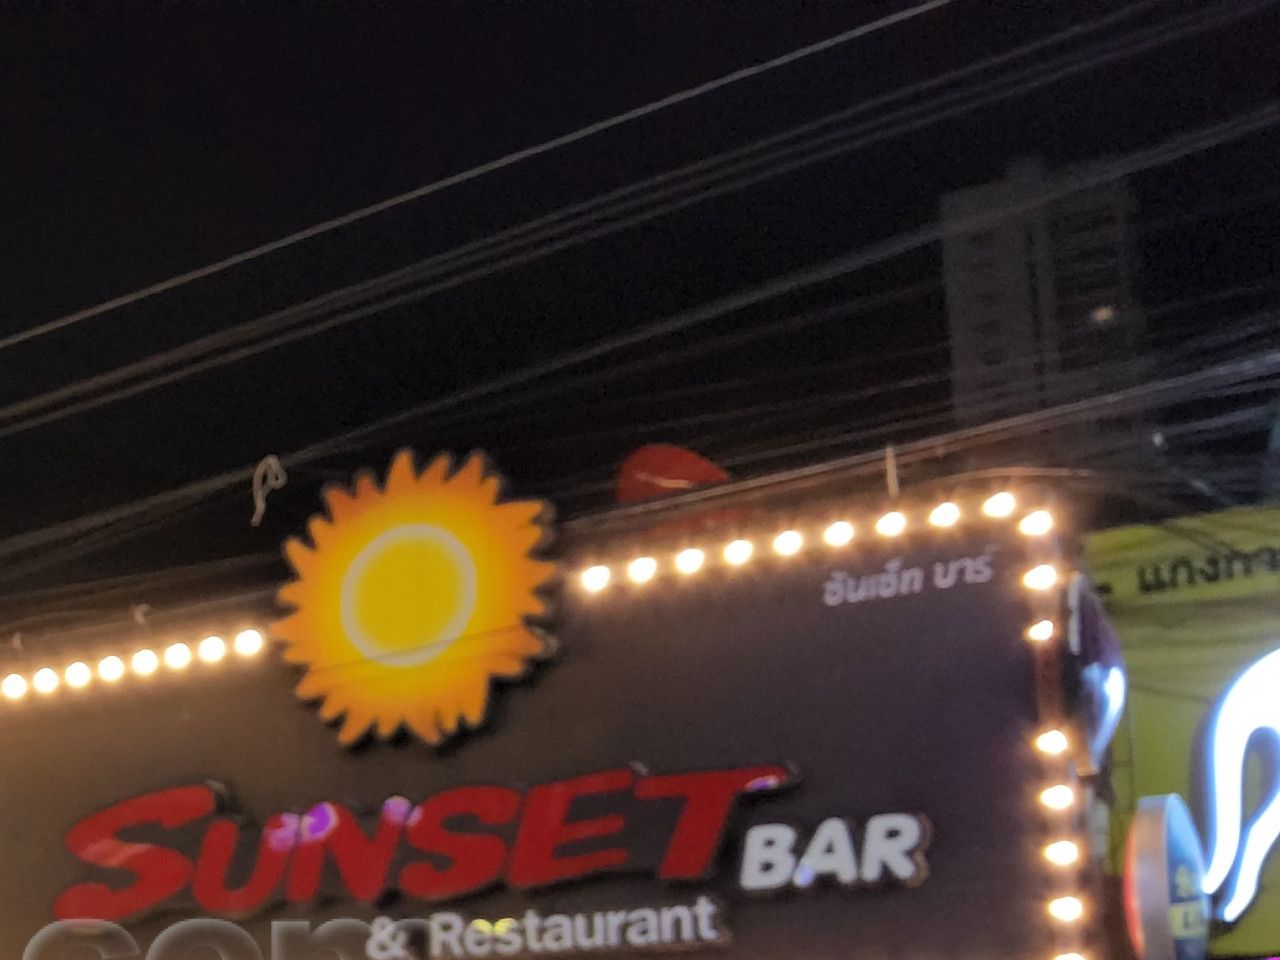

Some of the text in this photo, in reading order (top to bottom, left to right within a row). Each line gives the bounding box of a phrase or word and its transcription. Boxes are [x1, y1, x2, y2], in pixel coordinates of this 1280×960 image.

[52, 763, 924, 923] SUNSET BAR
[429, 896, 720, 959] Restaurant
